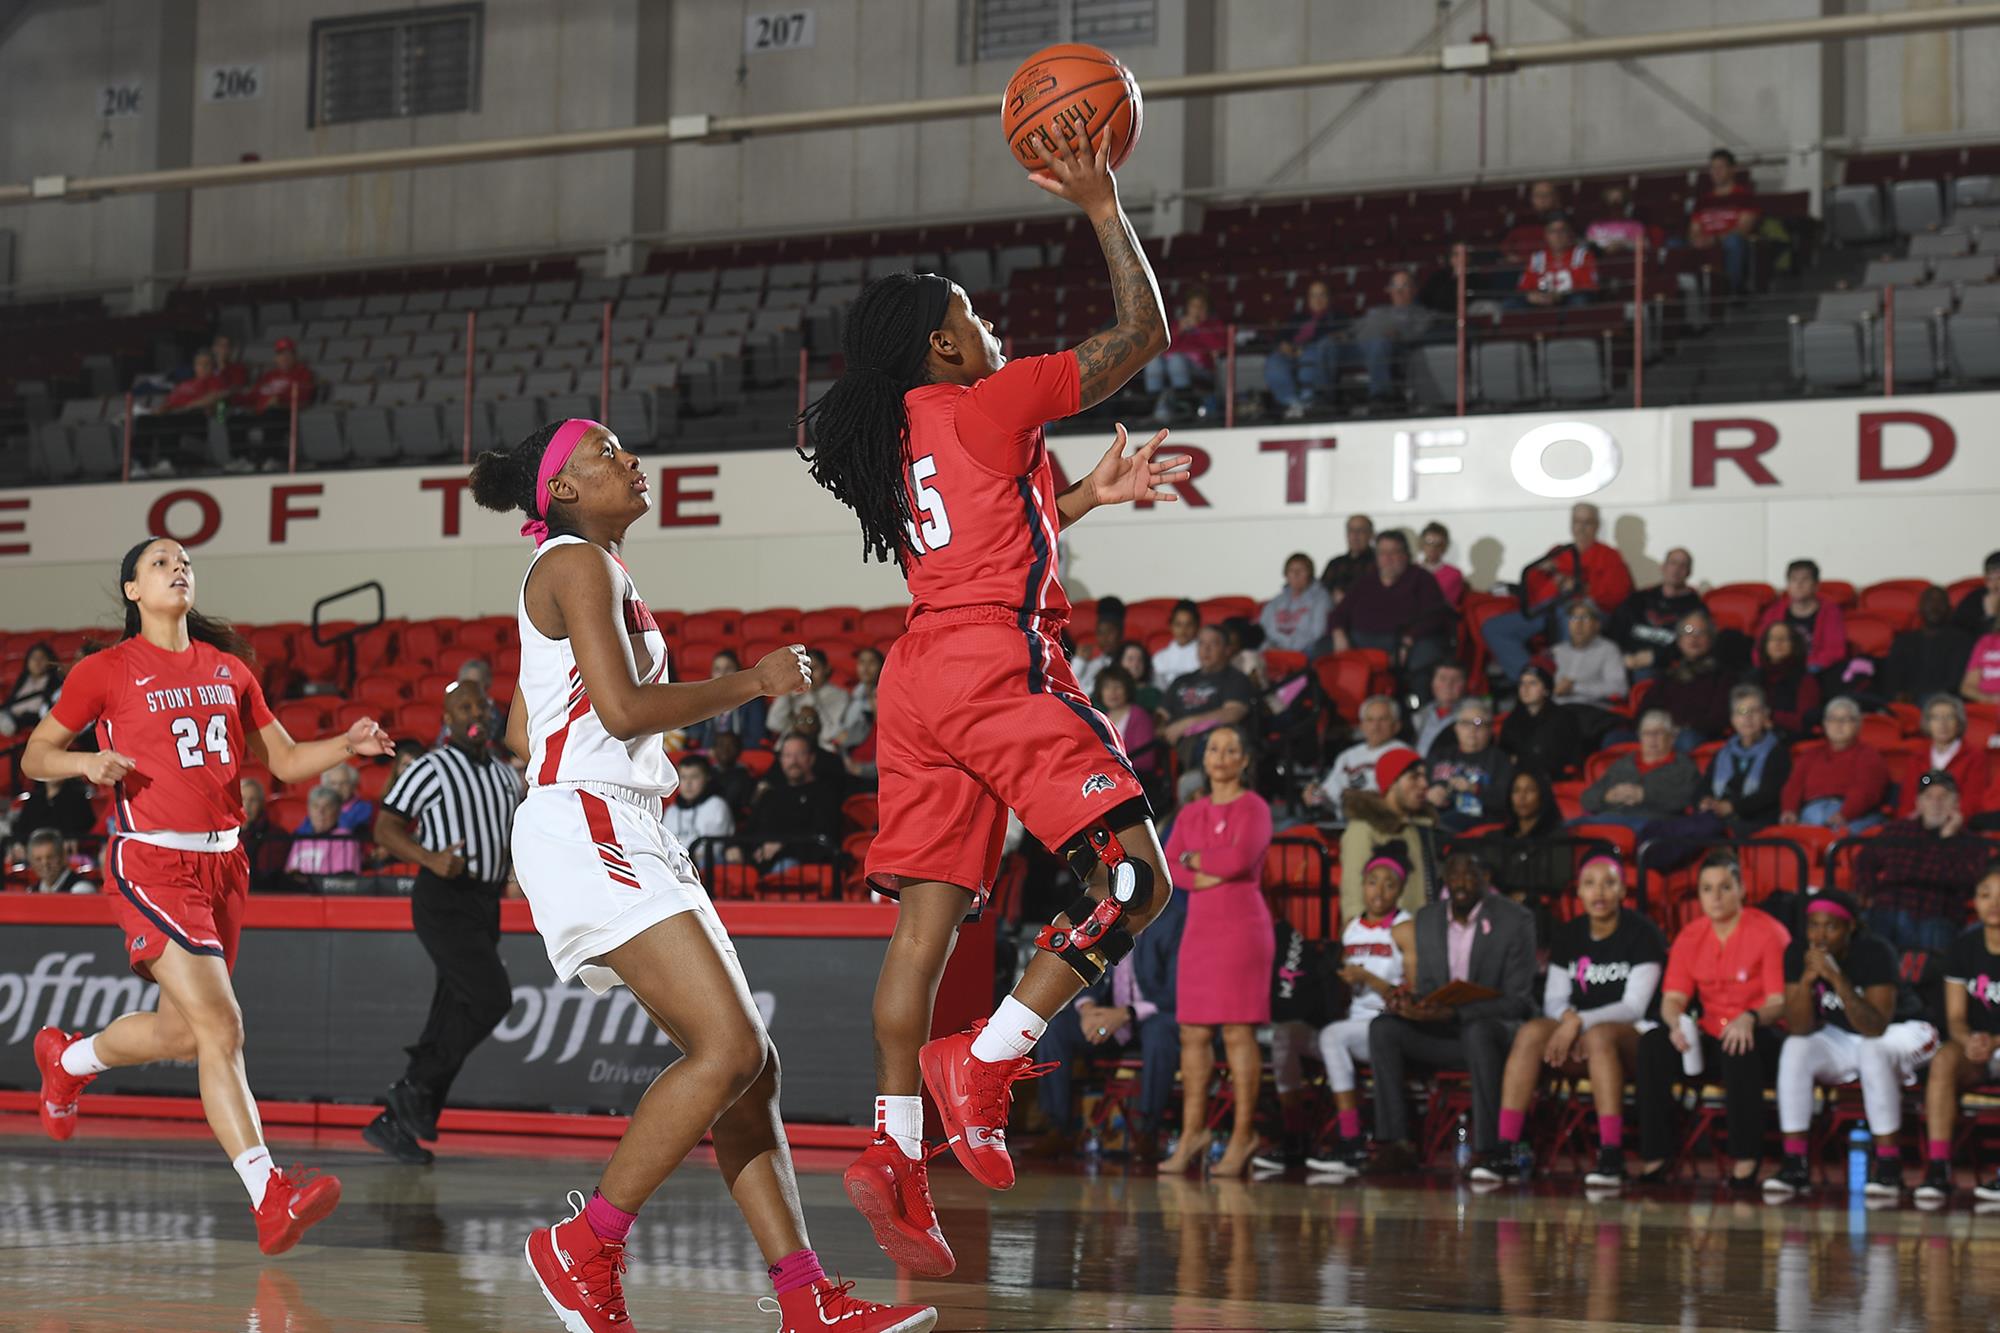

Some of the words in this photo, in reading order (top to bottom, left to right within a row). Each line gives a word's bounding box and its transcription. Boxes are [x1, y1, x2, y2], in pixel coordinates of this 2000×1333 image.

[757, 14, 806, 48] 207
[213, 69, 257, 99] 206
[1052, 98, 1098, 142] THE
[147, 482, 324, 548] OF
[420, 465, 721, 538] TE
[1046, 410, 1958, 511] RTFORD
[146, 686, 194, 714] STONY
[171, 713, 230, 769] 24
[0, 953, 159, 1045] offm
